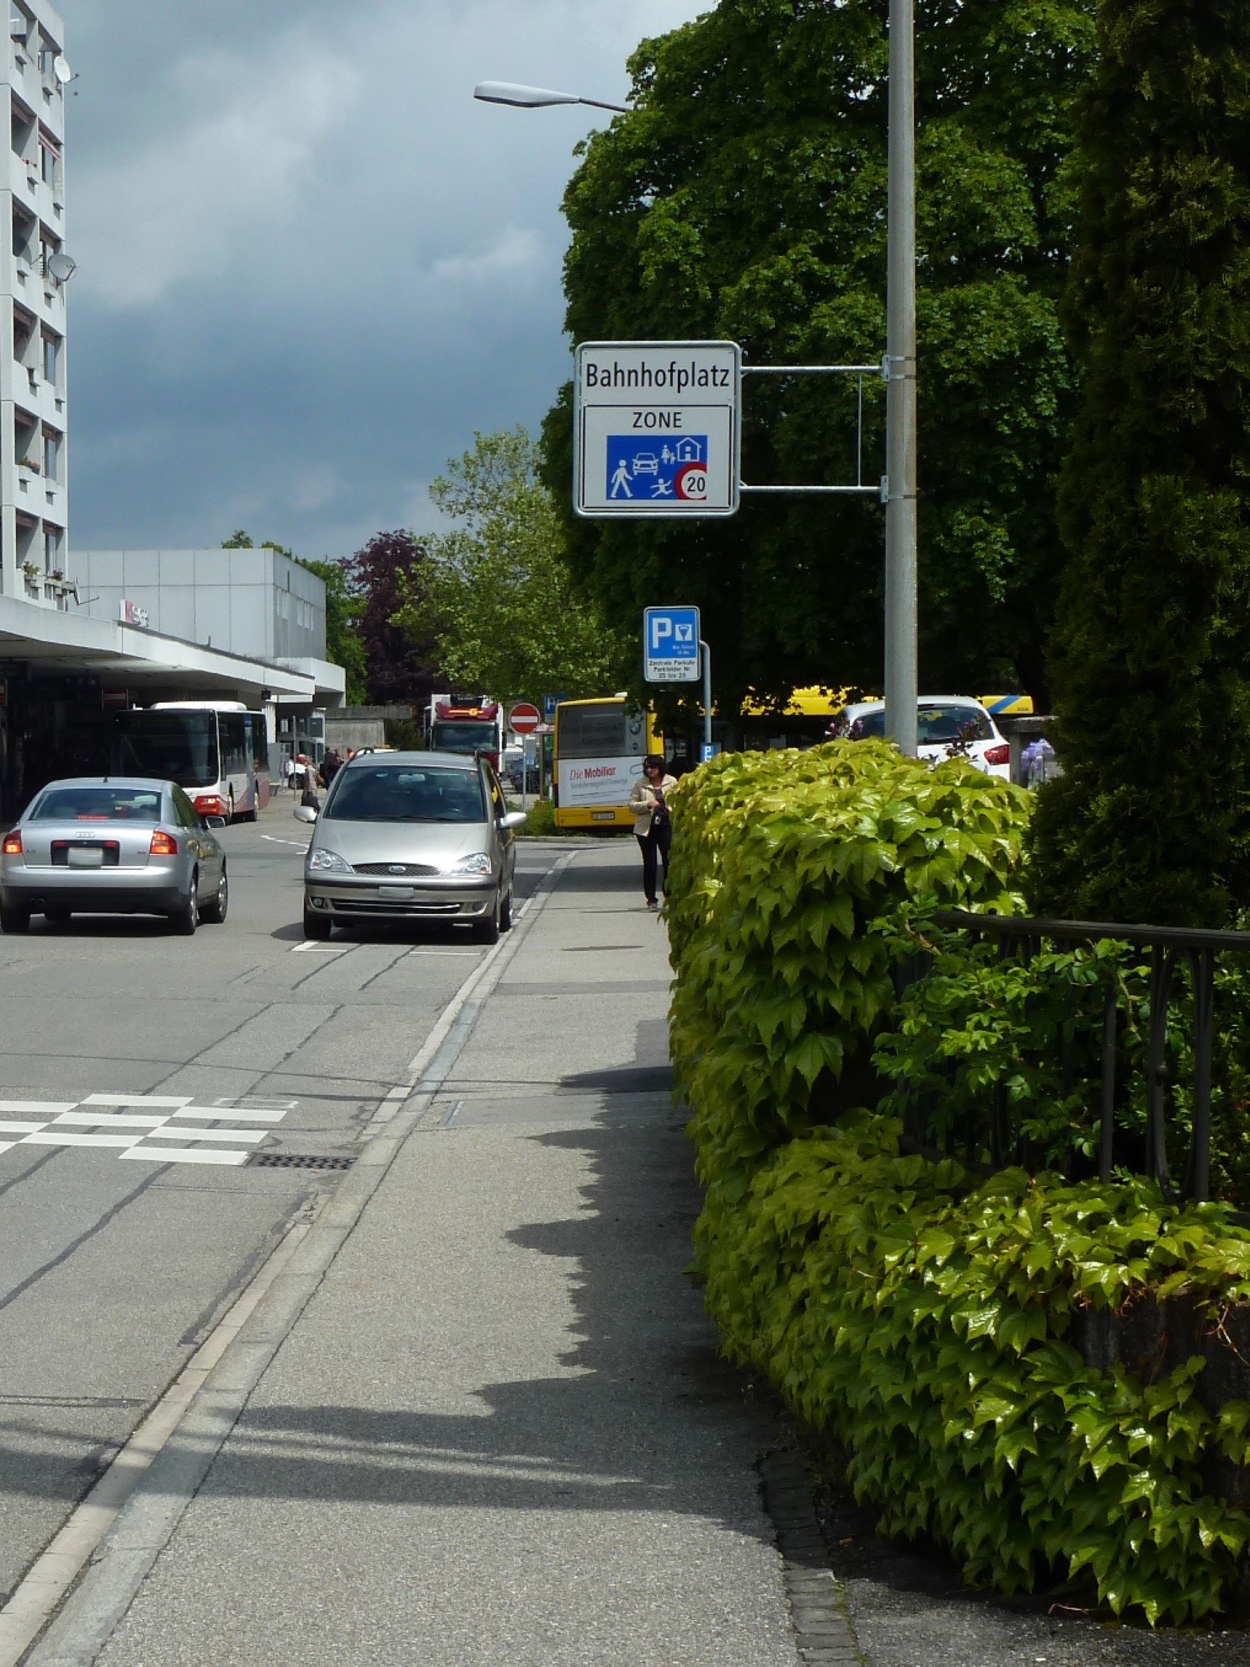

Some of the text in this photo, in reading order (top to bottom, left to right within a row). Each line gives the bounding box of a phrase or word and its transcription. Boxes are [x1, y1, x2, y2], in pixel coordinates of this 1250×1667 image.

[586, 361, 730, 393] Bahnhofplatz
[632, 412, 682, 428] ZONE
[687, 477, 706, 492] 20
[652, 617, 672, 649] P
[569, 766, 617, 780] Die Mobiliar
